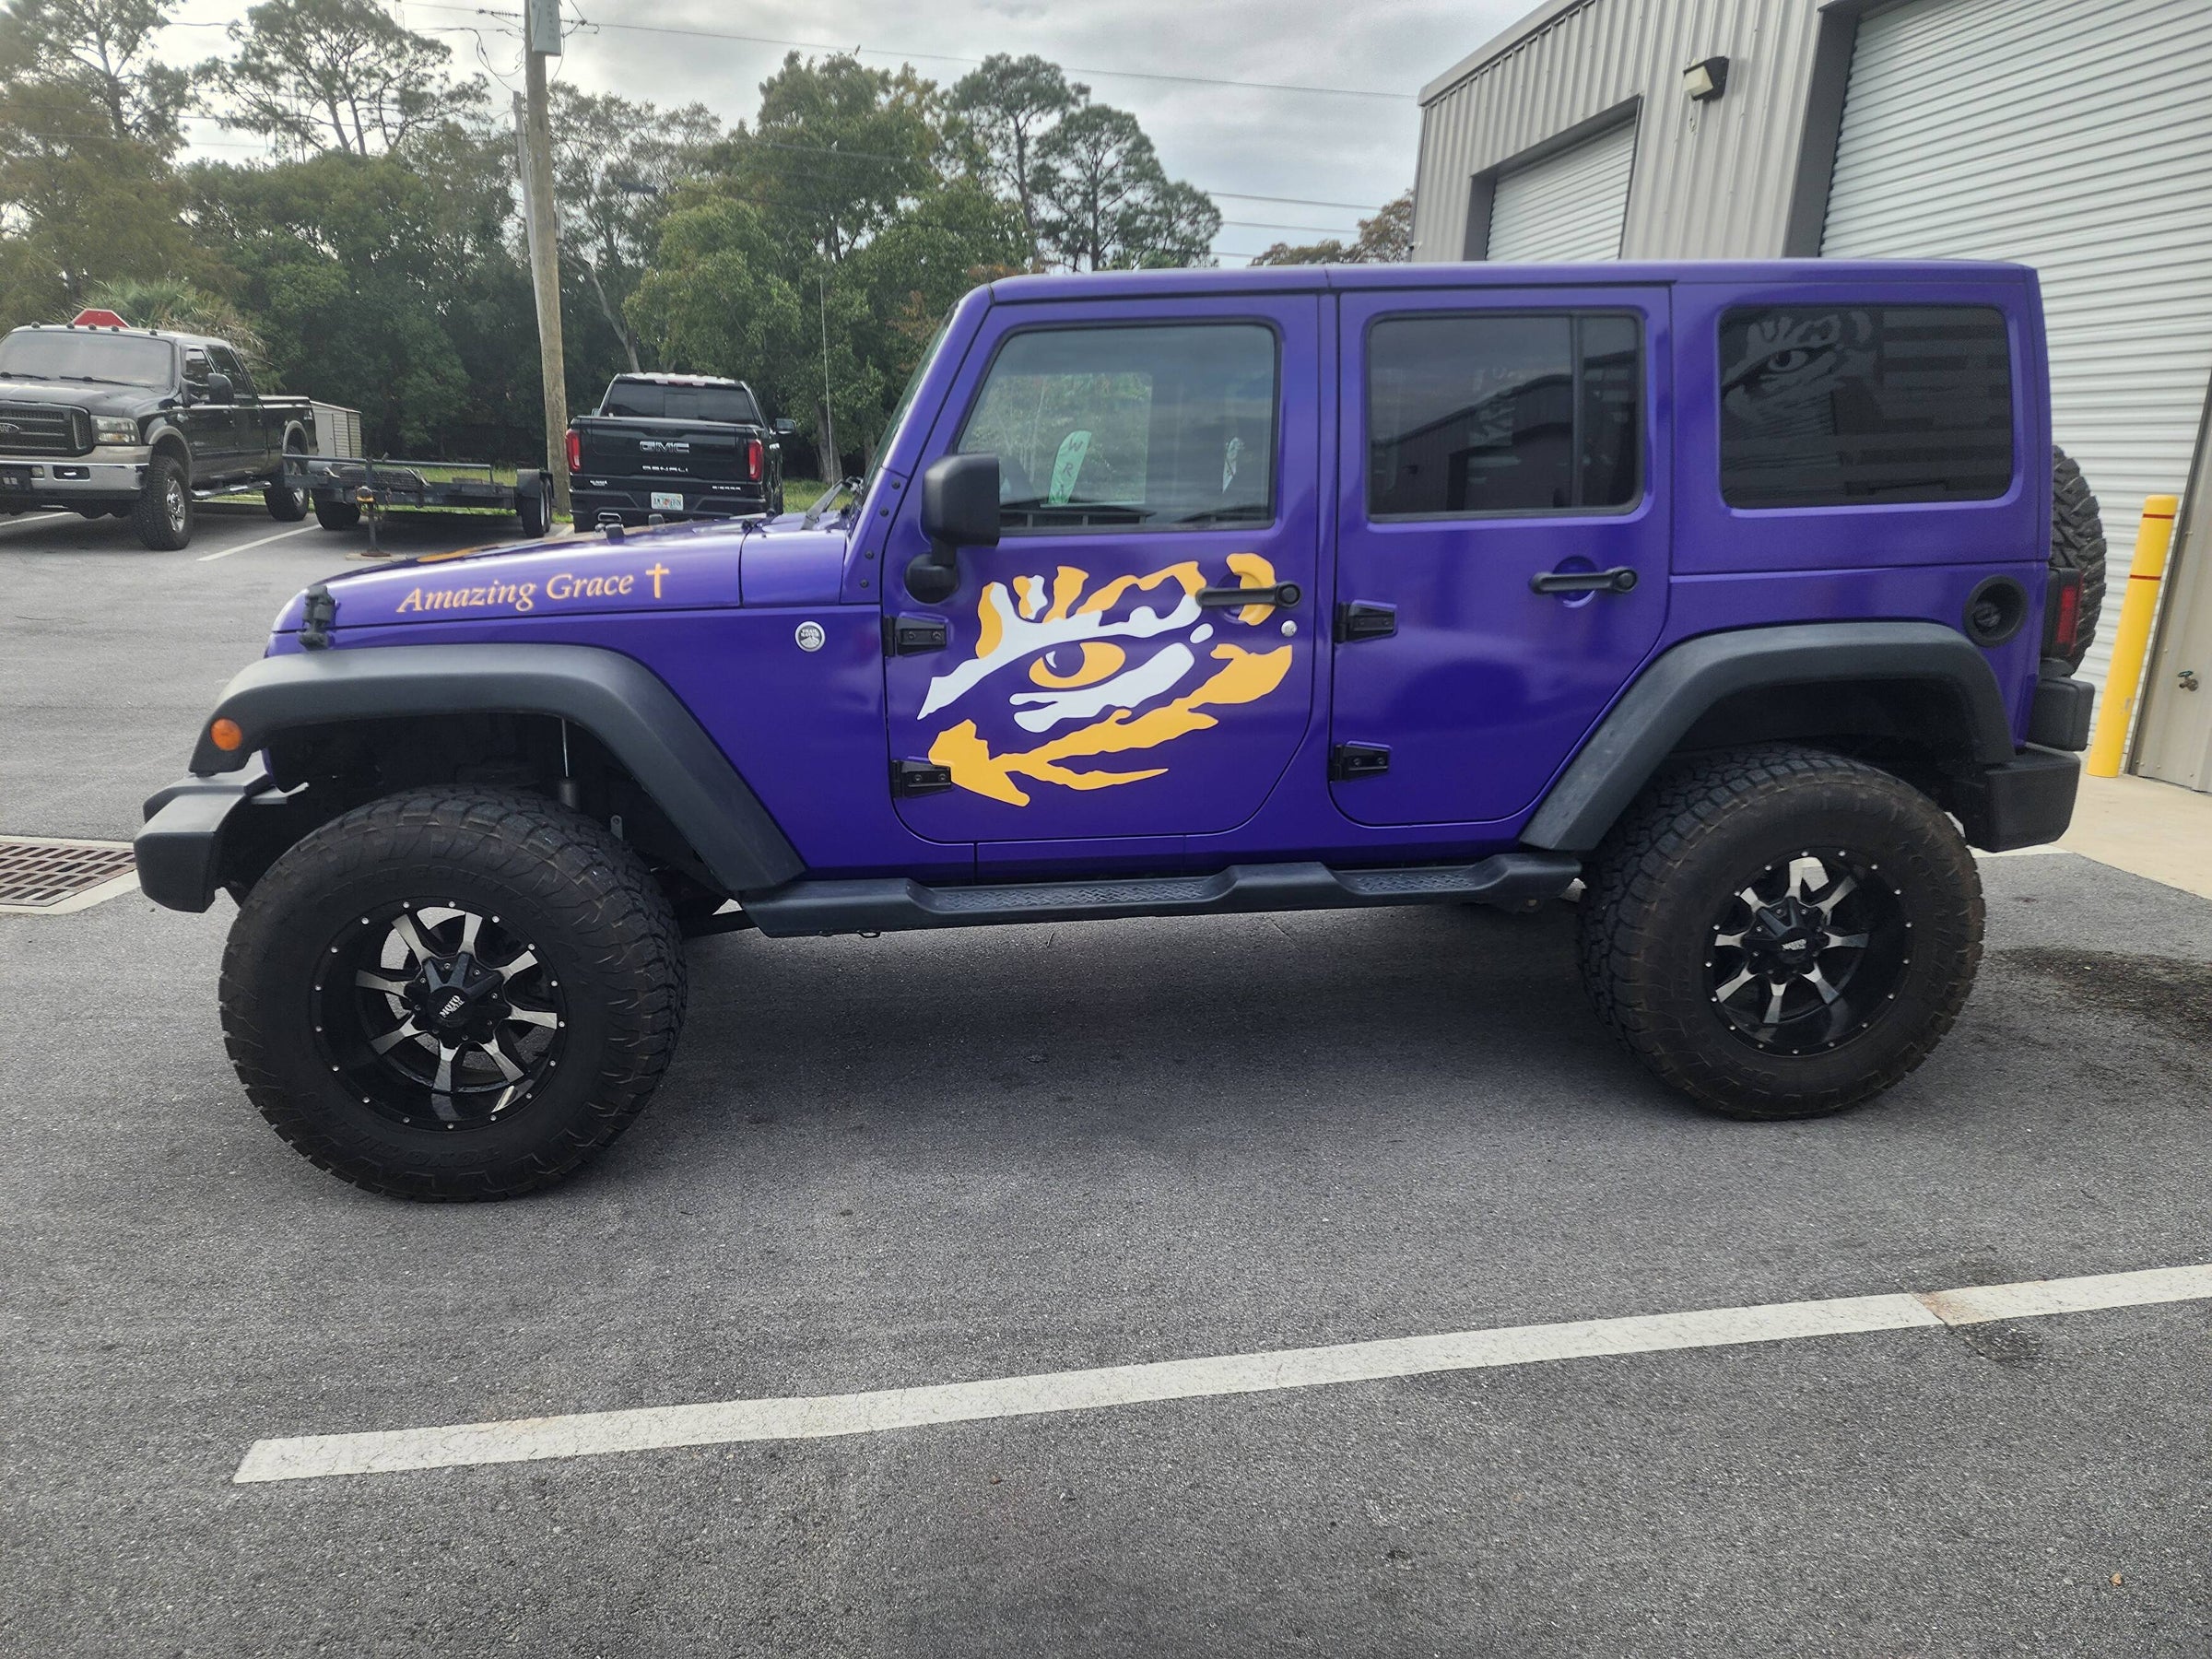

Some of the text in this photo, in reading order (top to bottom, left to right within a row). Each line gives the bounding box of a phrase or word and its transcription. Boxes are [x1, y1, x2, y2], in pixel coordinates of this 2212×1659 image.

[640, 441, 689, 454] GMC
[396, 573, 634, 612] Amazing Grace
